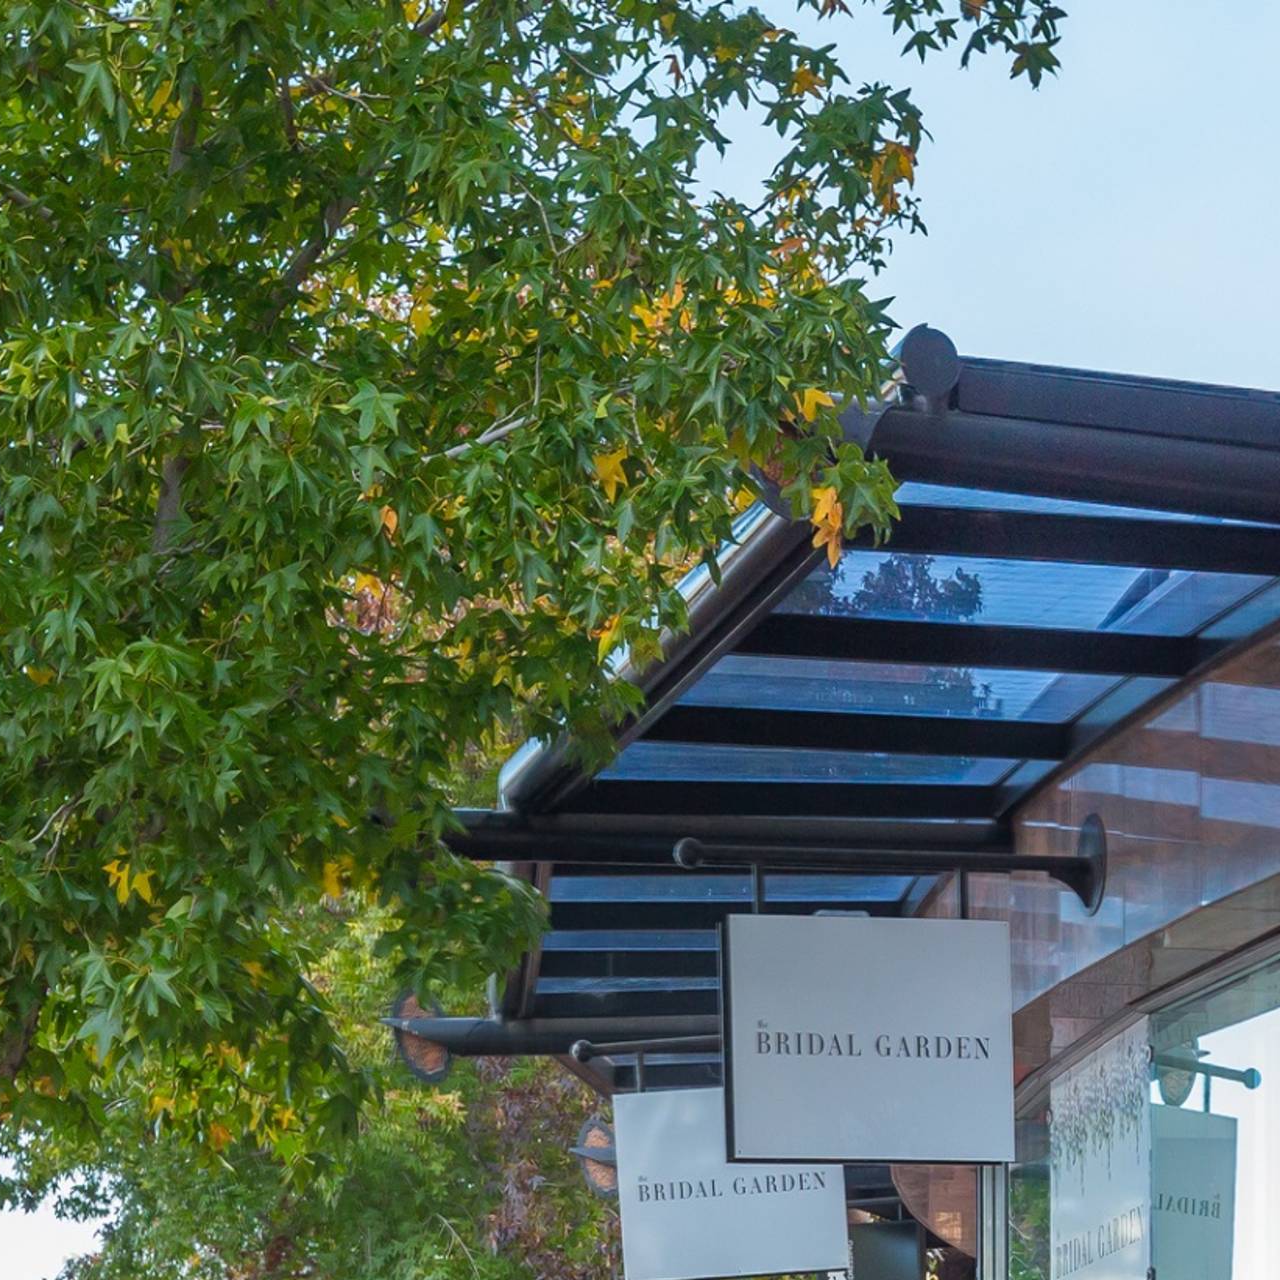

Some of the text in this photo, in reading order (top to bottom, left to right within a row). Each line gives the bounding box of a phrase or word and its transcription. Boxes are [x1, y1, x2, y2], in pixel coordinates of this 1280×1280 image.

[756, 1031, 991, 1060] BRIDAL GARDEN
[638, 1171, 826, 1202] BRIDAL GARDEN
[1055, 1204, 1145, 1279] BRIDAL GARDEN
